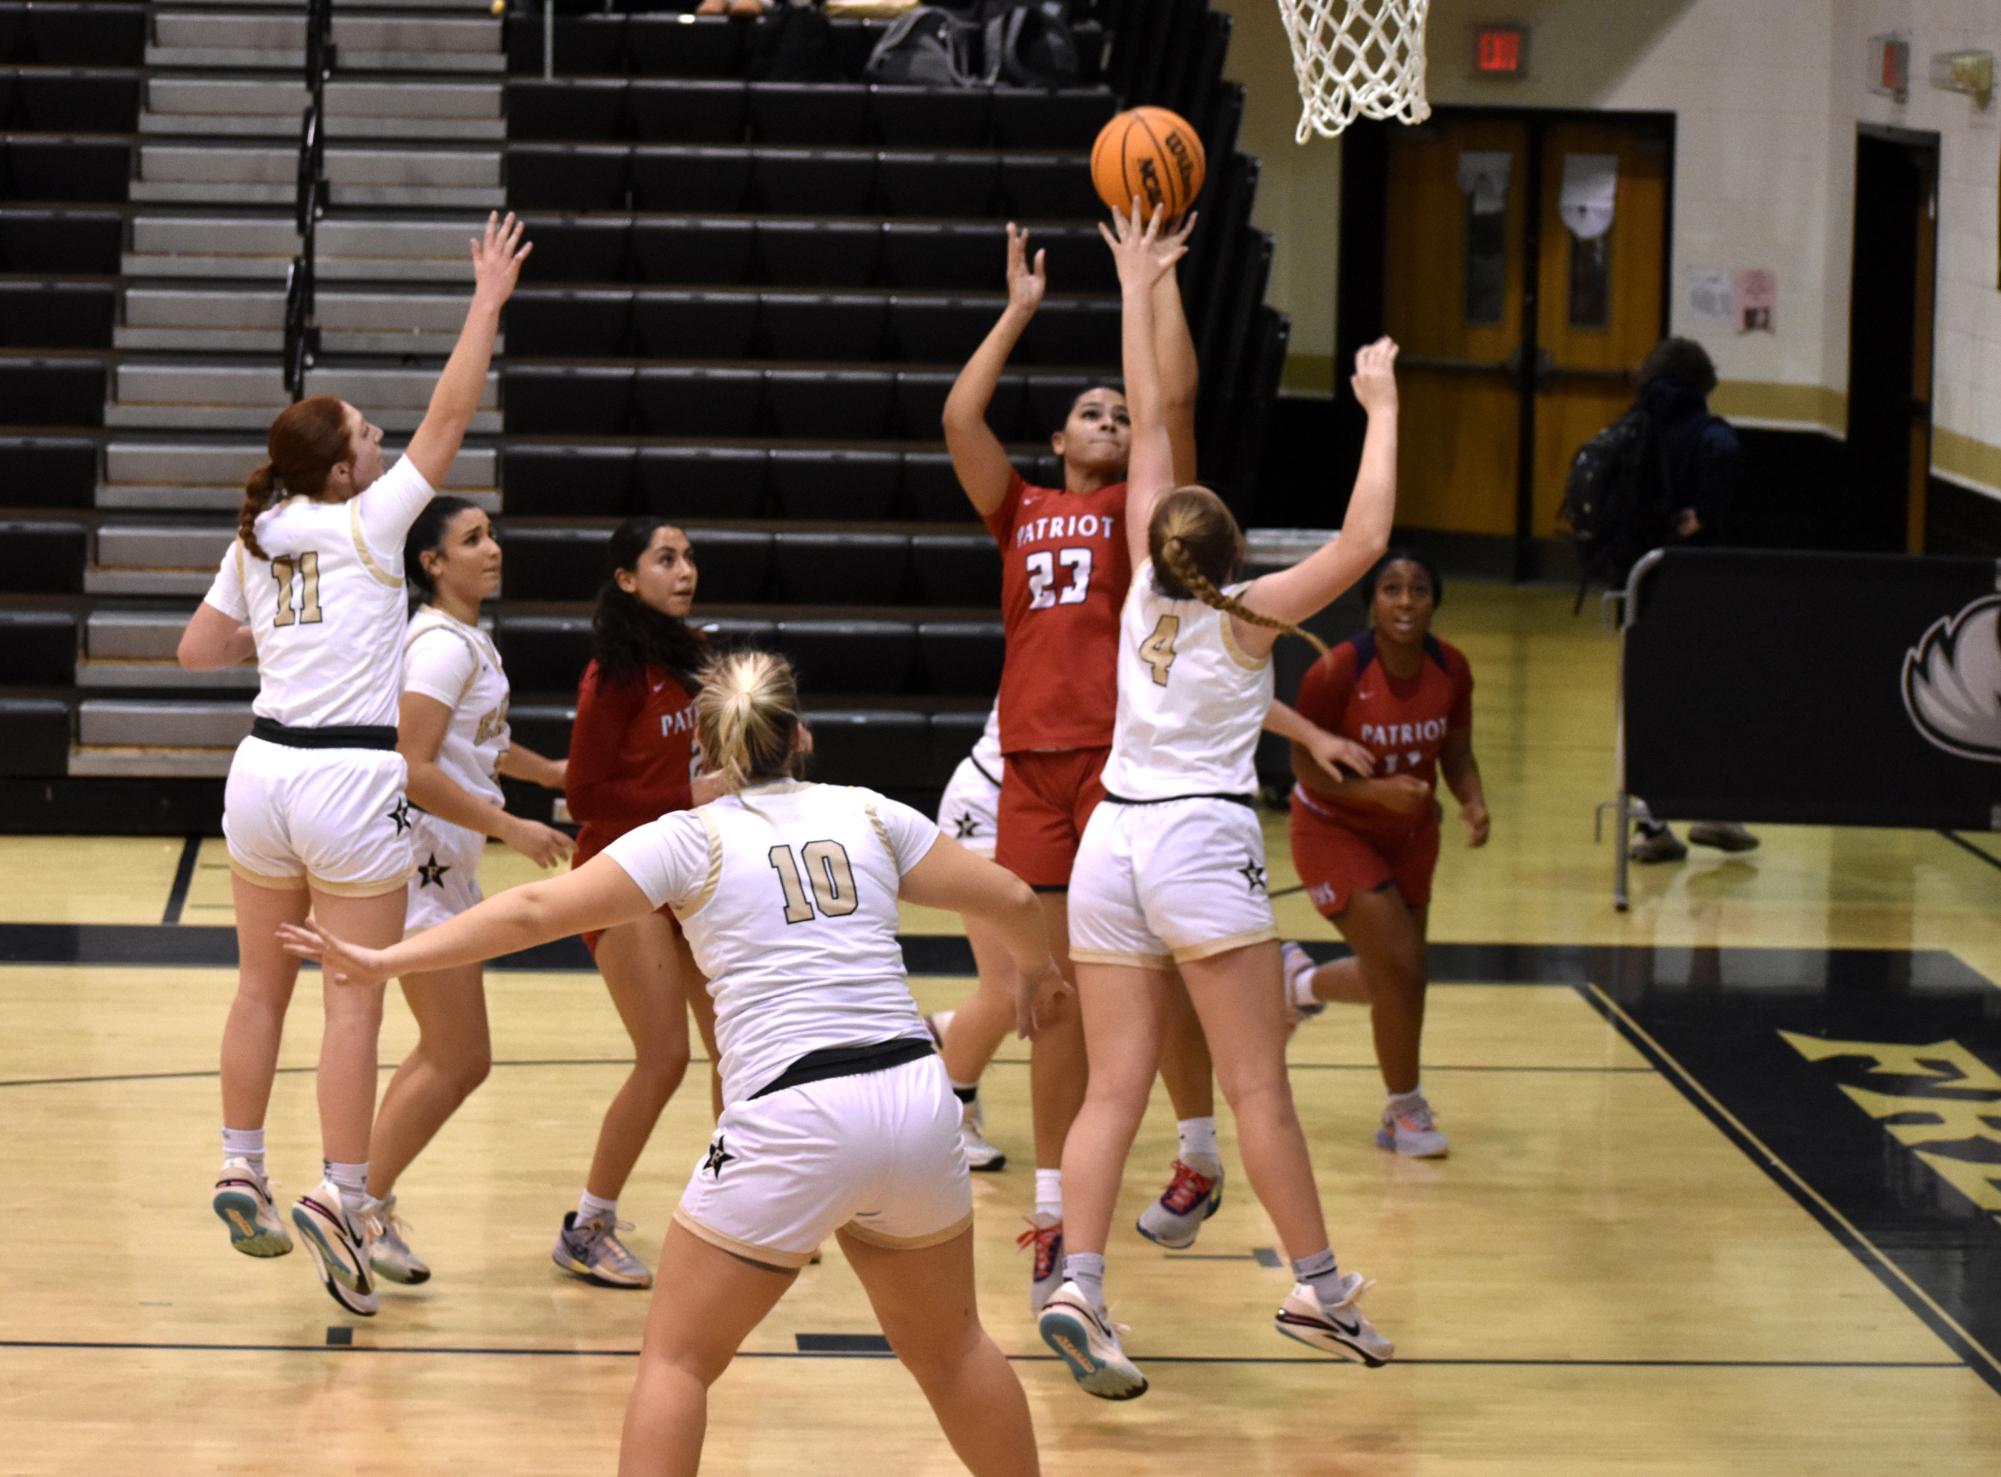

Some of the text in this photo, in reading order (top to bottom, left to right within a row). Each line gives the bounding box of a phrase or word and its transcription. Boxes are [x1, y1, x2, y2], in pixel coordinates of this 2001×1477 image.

[271, 551, 322, 628] 11
[1026, 548, 1091, 610] 23
[1139, 614, 1180, 687] 4
[768, 839, 858, 924] 10
